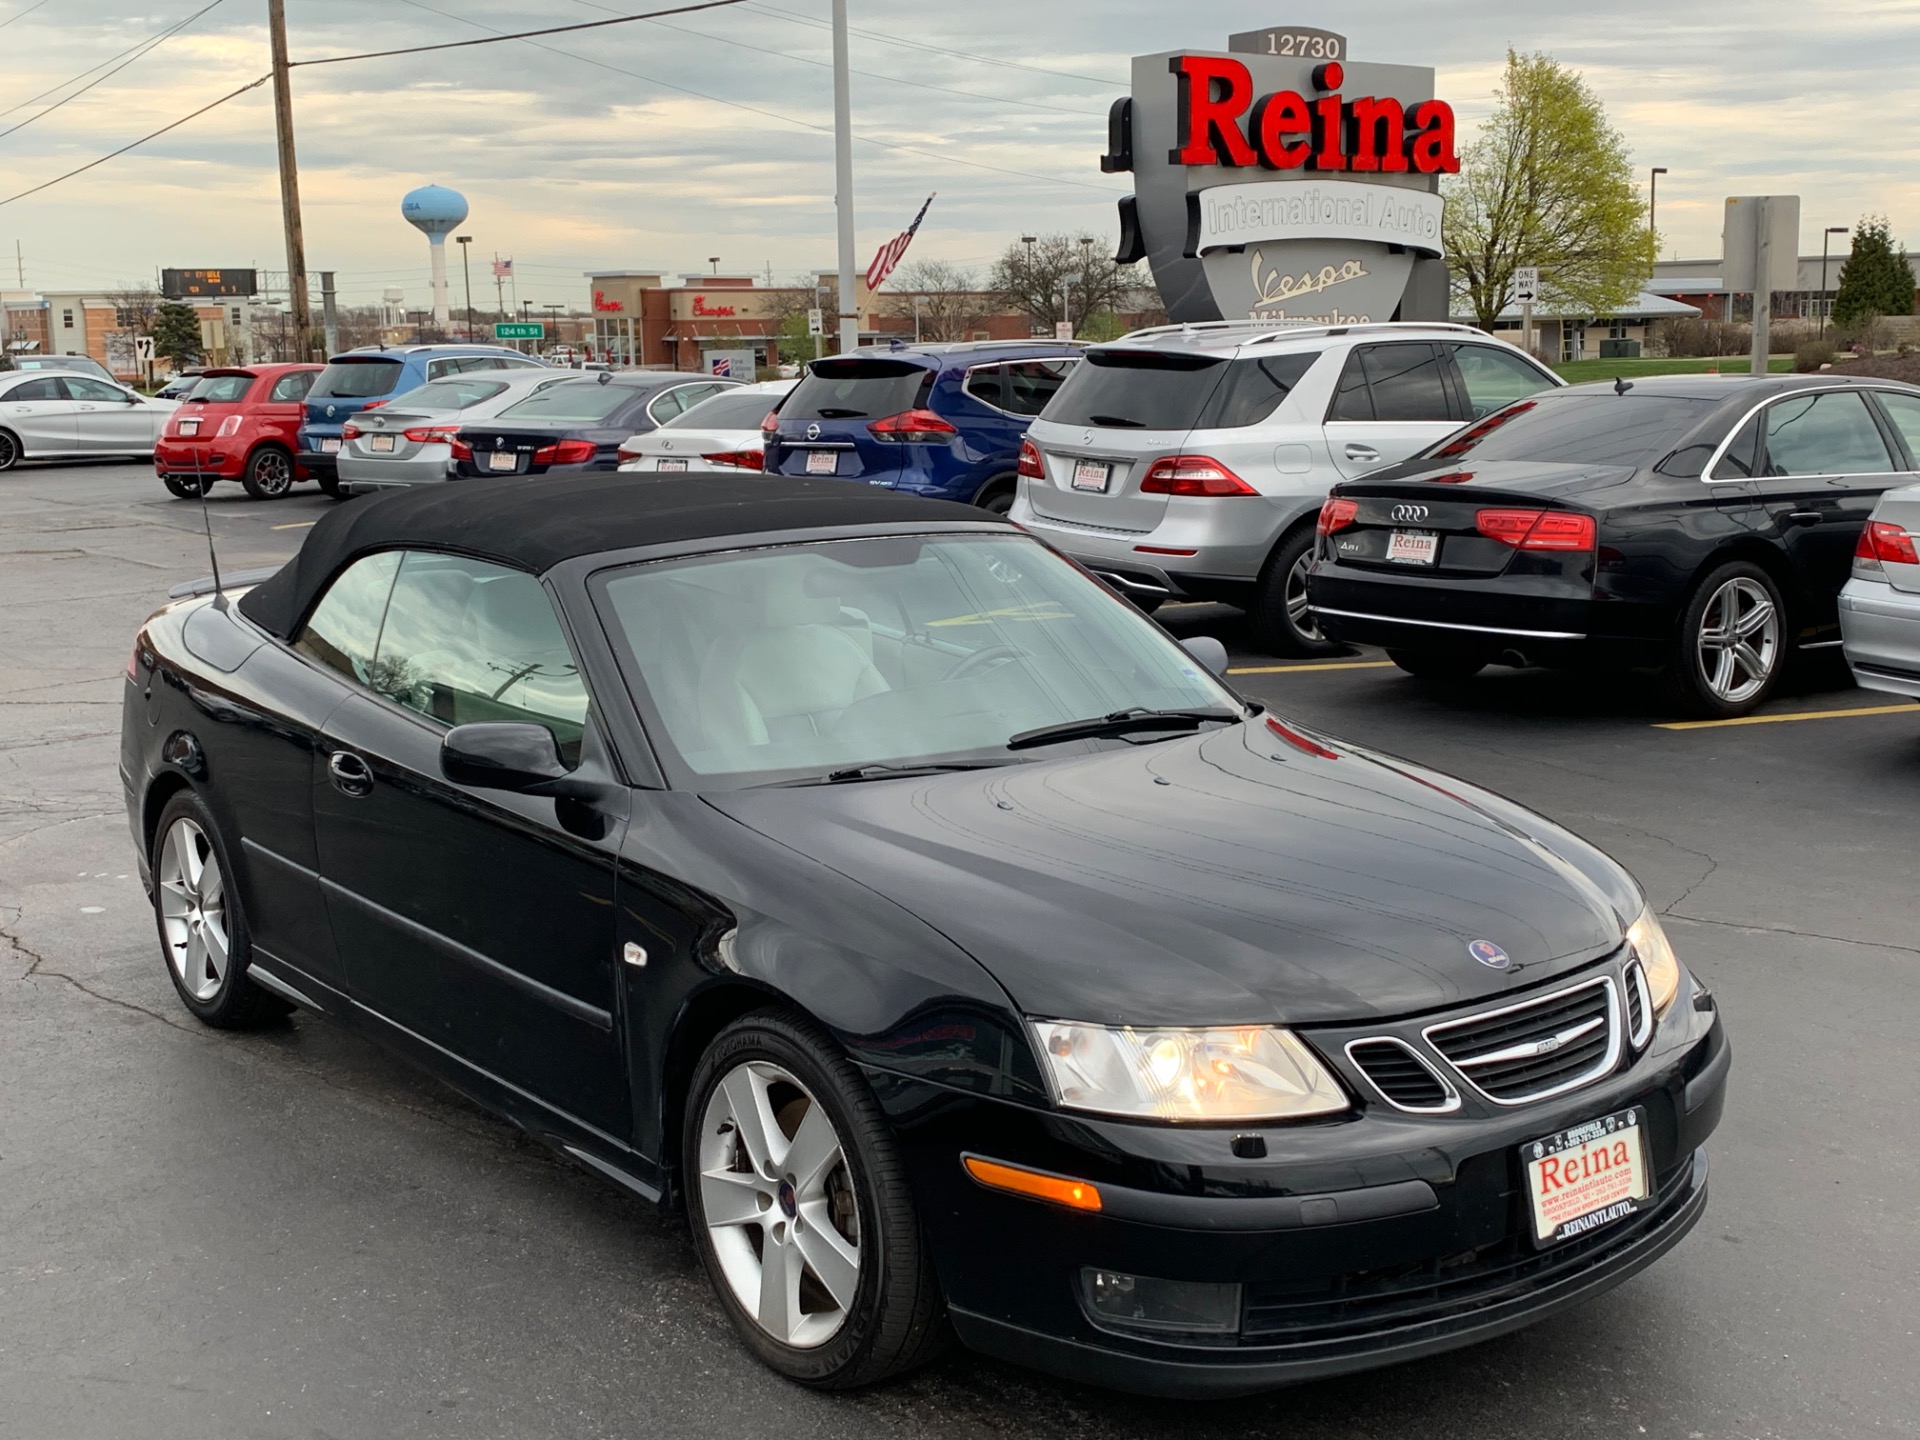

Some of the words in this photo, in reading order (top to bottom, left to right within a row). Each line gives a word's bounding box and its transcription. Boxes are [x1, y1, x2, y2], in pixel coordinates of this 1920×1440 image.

[1267, 33, 1340, 59] 12730
[1172, 56, 1461, 174] Reina
[1207, 189, 1374, 235] International
[1378, 195, 1437, 240] Auto
[1251, 248, 1371, 309] Vespa
[1518, 270, 1534, 279] ONE
[1518, 280, 1534, 289] WAY
[529, 327, 538, 335] St
[810, 454, 834, 464] Reina
[1078, 465, 1105, 479] Reina
[1393, 534, 1432, 550] Reina
[1538, 1139, 1630, 1195] Reina
[1541, 1168, 1632, 1208] www.reinaintlauto.com
